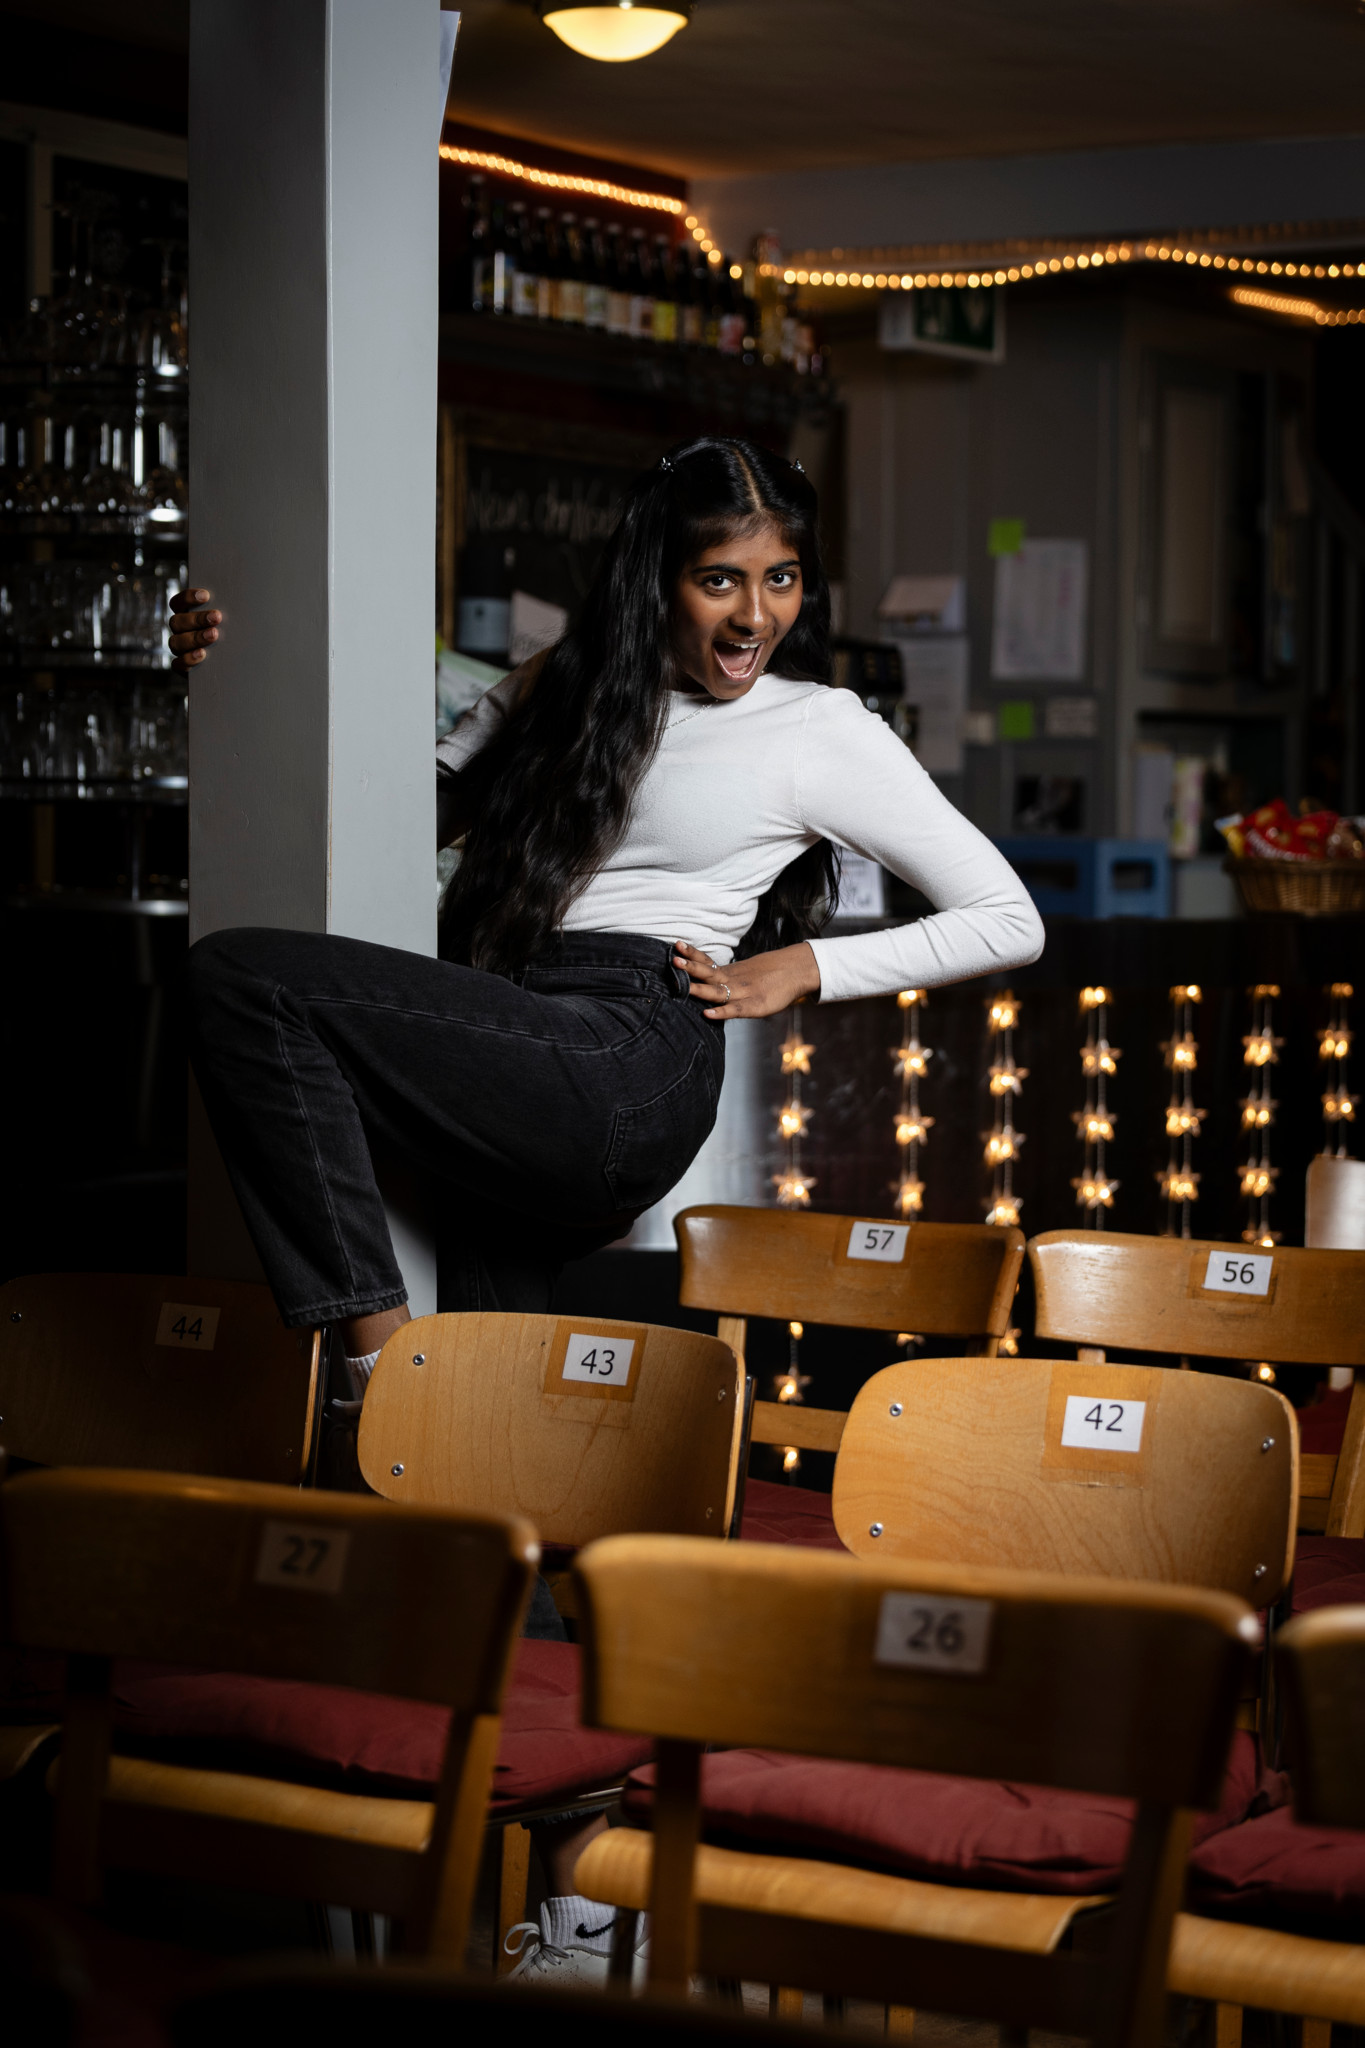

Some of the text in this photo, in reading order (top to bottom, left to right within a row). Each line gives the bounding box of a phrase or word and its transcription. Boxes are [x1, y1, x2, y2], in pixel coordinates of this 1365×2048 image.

[864, 1228, 895, 1251] 57
[1222, 1260, 1255, 1285] 56
[170, 1315, 203, 1342] 44
[580, 1348, 616, 1377] 43
[1084, 1403, 1124, 1433] 42
[279, 1536, 330, 1577] 27
[907, 1610, 965, 1655] 26
